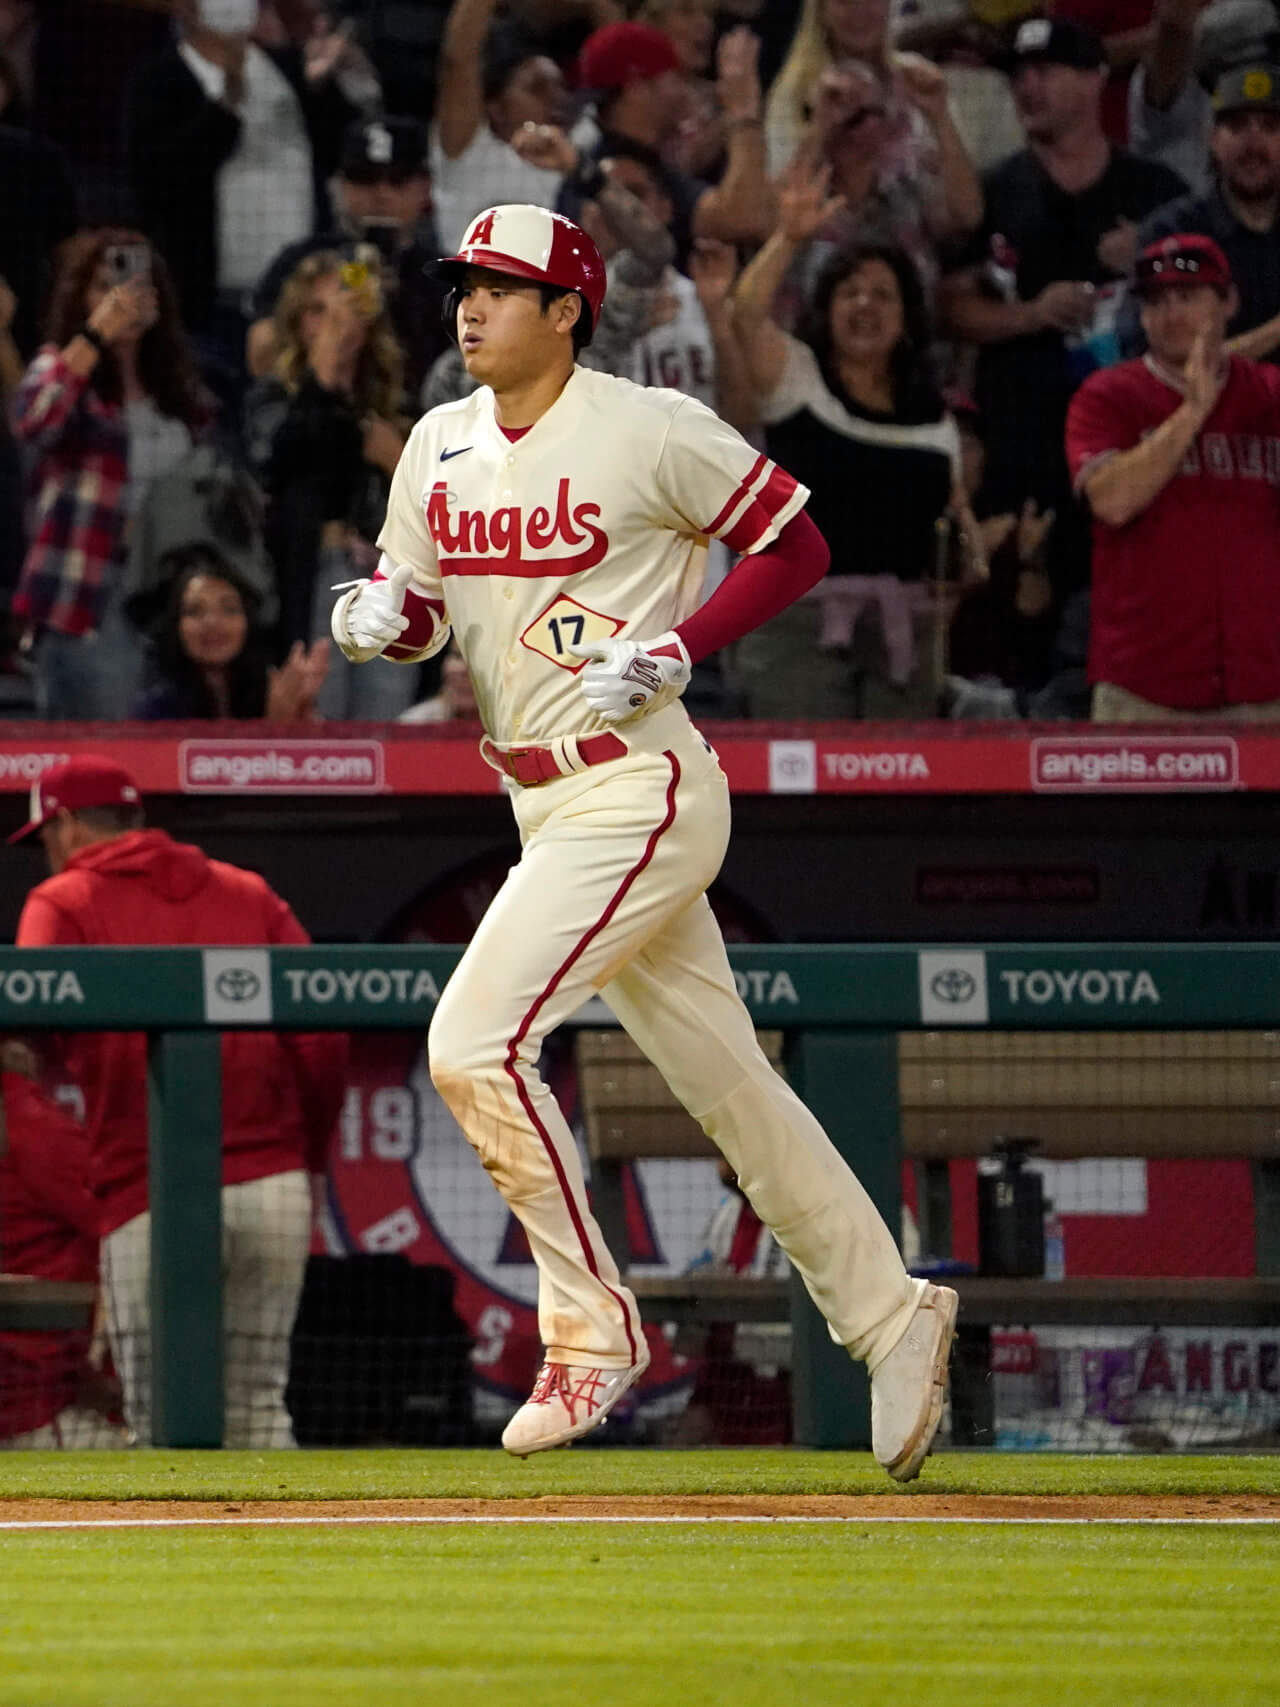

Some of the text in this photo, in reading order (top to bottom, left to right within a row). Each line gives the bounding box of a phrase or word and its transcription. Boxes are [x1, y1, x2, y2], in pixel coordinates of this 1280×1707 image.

[467, 210, 497, 246] A
[426, 478, 609, 578] Angels
[548, 615, 585, 655] 17
[190, 752, 373, 784] angels.com
[825, 753, 929, 778] TOYOTA
[1041, 750, 1228, 780] angels.com
[285, 969, 440, 1003] TOYOTA
[1001, 970, 1160, 1004] TOYOTA
[339, 1086, 417, 1160] 19
